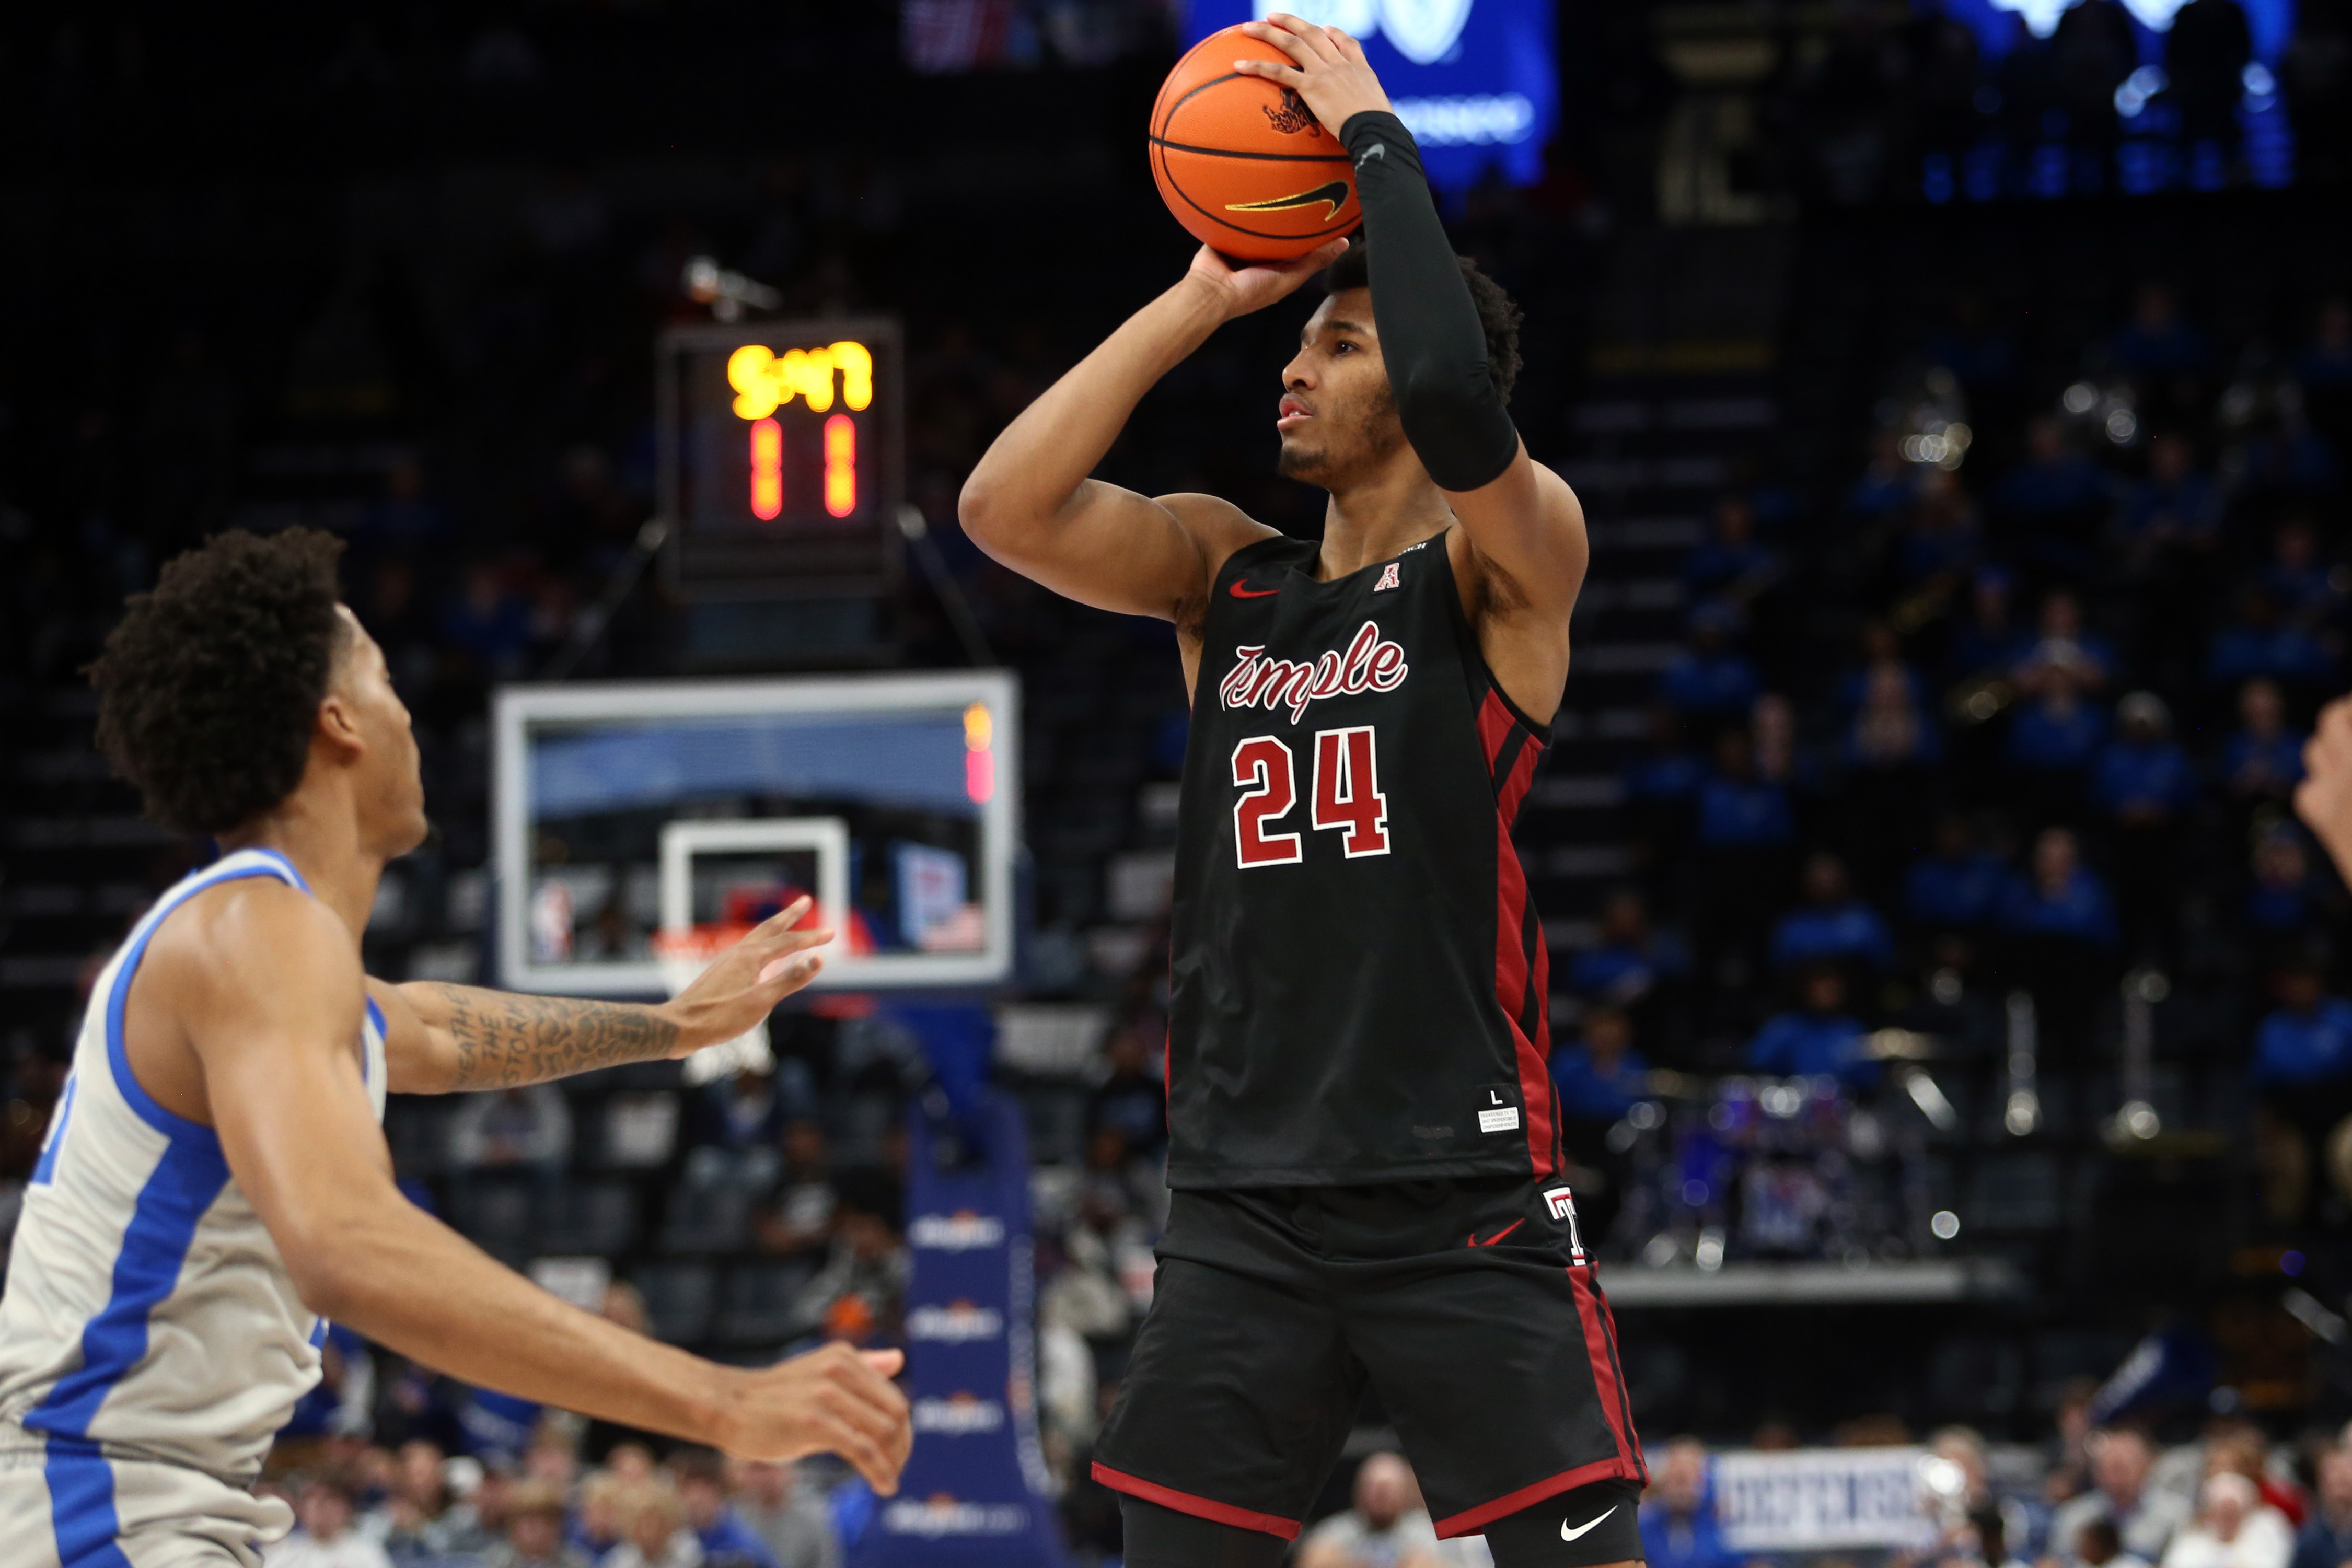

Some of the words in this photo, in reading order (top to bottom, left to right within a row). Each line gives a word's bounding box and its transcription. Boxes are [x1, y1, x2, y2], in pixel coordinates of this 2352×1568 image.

[1219, 620, 1409, 725] Temple
[1231, 725, 1391, 869] 24
[1490, 1090, 1503, 1105] L
